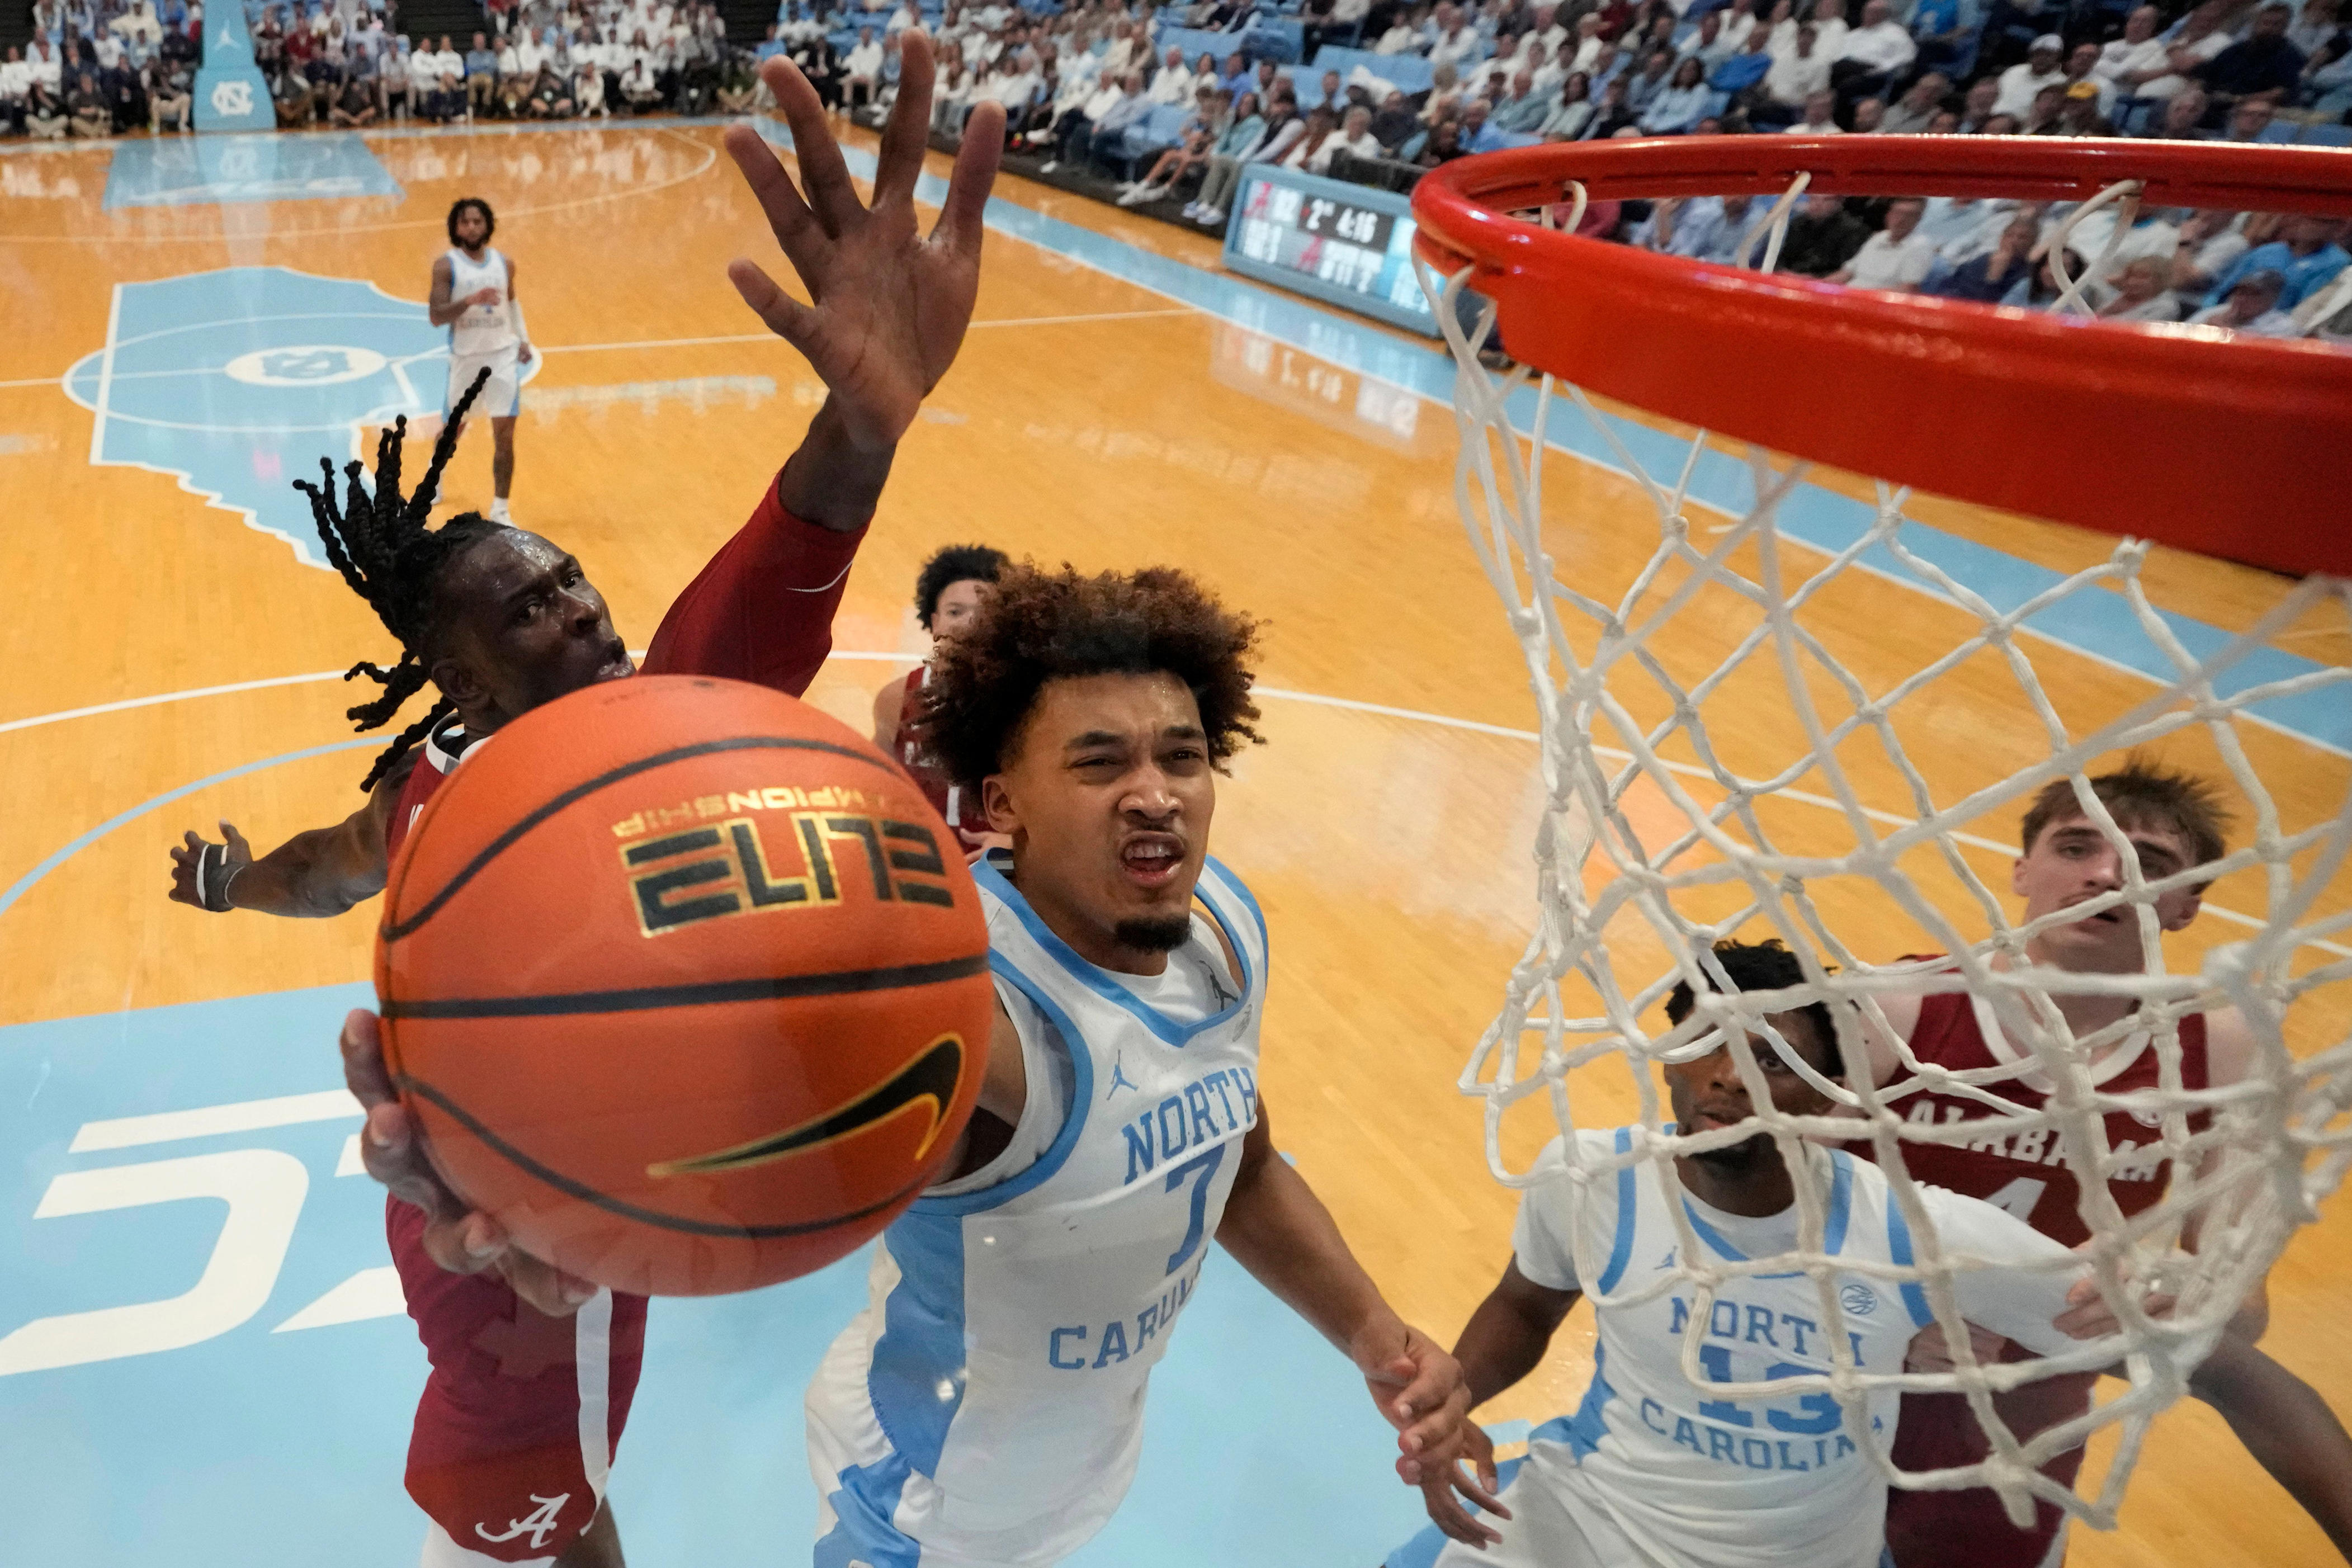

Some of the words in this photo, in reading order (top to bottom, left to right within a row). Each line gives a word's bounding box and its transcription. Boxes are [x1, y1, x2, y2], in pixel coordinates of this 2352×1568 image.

[611, 784, 917, 838] MPIONSHIP
[618, 811, 955, 938] ELITE
[1121, 1066, 1257, 1186] NORTH
[1164, 1142, 1225, 1276] 7
